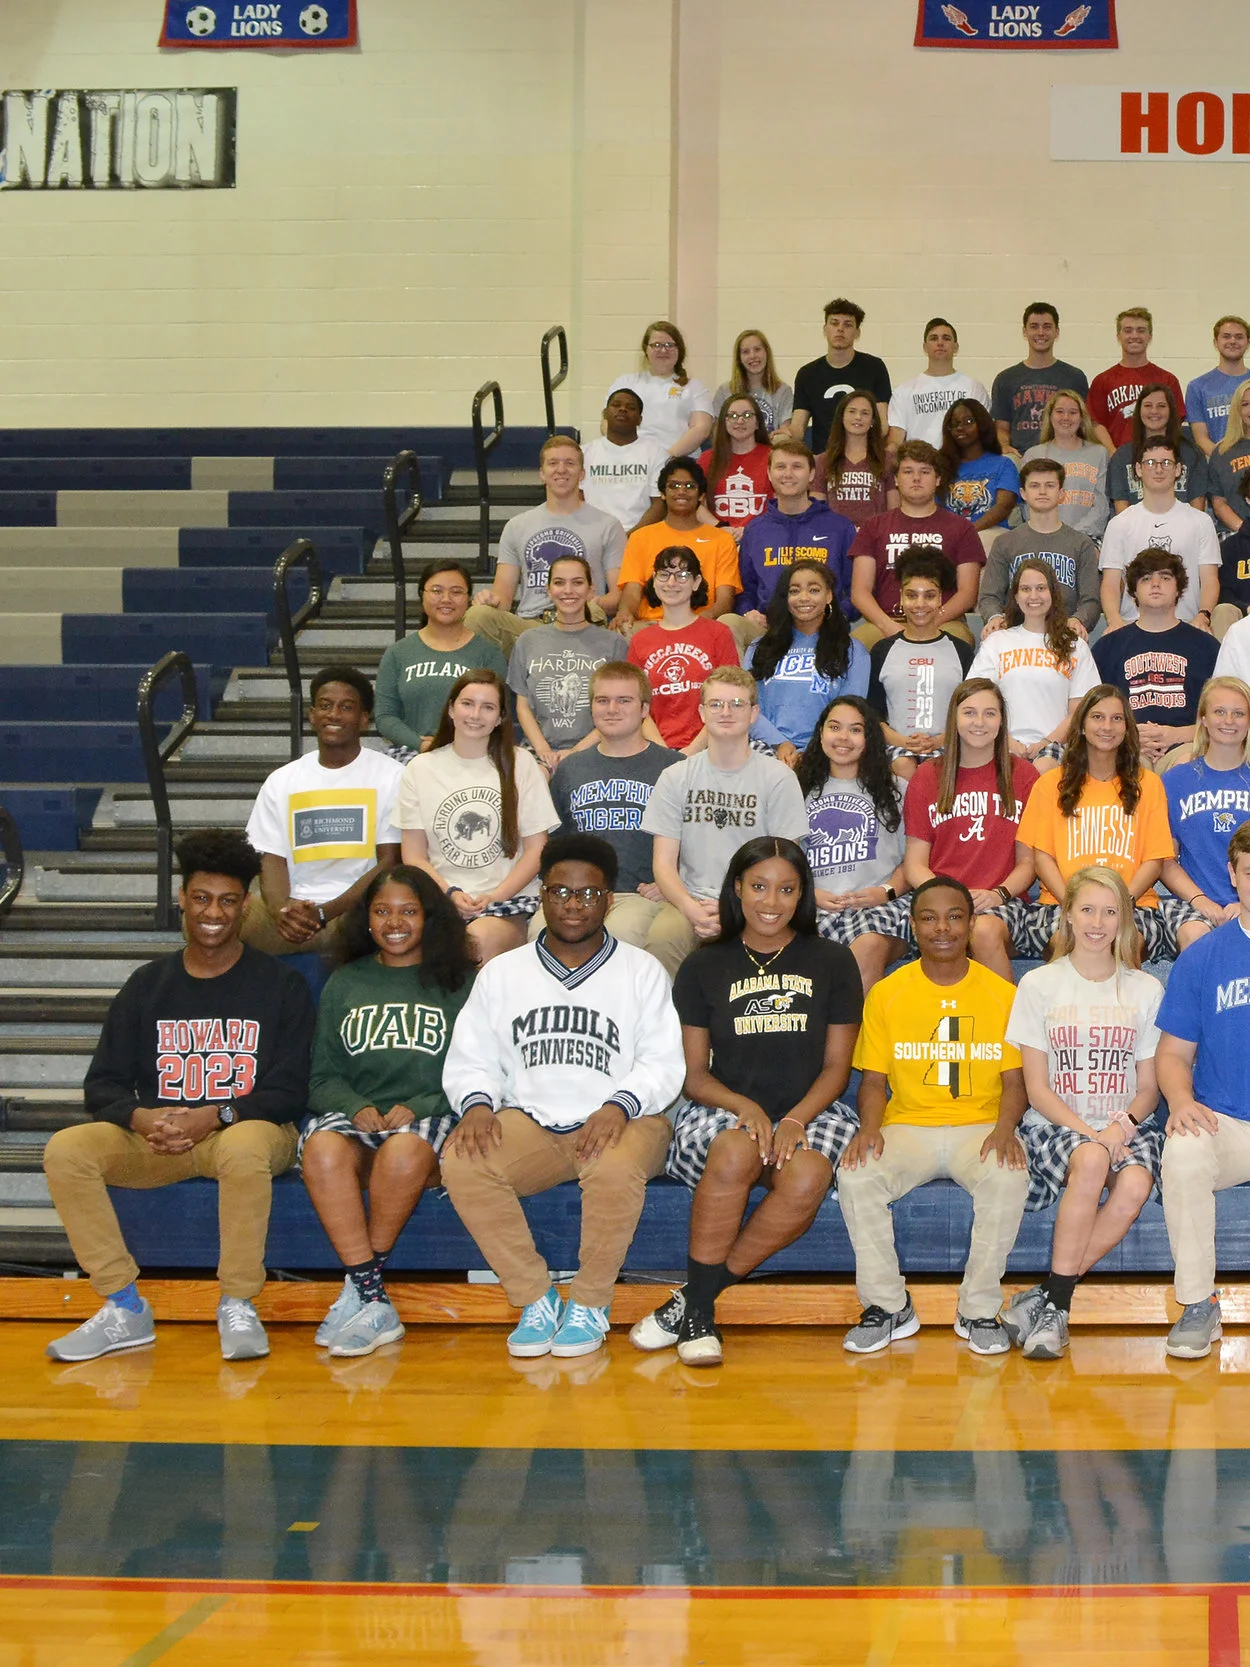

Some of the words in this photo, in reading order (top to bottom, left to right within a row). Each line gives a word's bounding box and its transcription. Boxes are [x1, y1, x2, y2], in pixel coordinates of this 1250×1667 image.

[234, 4, 281, 21] LADY
[990, 4, 1040, 21] LADY
[231, 20, 283, 37] LIONS
[988, 20, 1042, 38] LIONS
[4, 90, 219, 183] NATION
[913, 391, 956, 403] UNIVERSITY
[957, 390, 967, 400] OF
[915, 401, 955, 415] UNCOMMIT
[589, 464, 648, 477] MILLIKIN
[836, 487, 870, 501] STATE
[714, 498, 767, 518] CBU
[889, 533, 908, 544] WE
[911, 533, 943, 544] RING
[764, 547, 778, 566] L
[405, 661, 472, 683] TULAN
[908, 657, 935, 666] CBU
[998, 647, 1078, 681] TENNESE
[1124, 651, 1188, 681] SOUTHWEST
[659, 679, 691, 695] CBU
[552, 718, 576, 728] WAY
[435, 793, 468, 830] HARDING
[471, 790, 503, 812] UNIVER
[806, 795, 835, 814] PSCOMB
[838, 795, 875, 821] UNIVERSITY
[992, 793, 1022, 824] TE
[314, 817, 355, 825] RICHMOND
[314, 825, 355, 834] UNIVERSITY
[572, 807, 643, 832] TIGER
[959, 815, 986, 842] A
[1066, 804, 1139, 863] TENNESSE
[440, 838, 459, 862] FEAR
[461, 854, 479, 868] THE
[806, 839, 869, 868] BISONS
[812, 867, 835, 878] SINCE
[728, 974, 780, 1003] ALABAMA
[781, 974, 813, 998] STATE
[340, 1003, 446, 1056] UAB
[511, 1005, 621, 1055] MIDDLE
[733, 1013, 808, 1035] UNIVERSITY
[156, 1018, 260, 1053] HOWARD
[1048, 1026, 1084, 1048] HAIL
[1088, 1026, 1137, 1047] STATE
[521, 1038, 613, 1077] TENNESSEE
[893, 1041, 966, 1061] SOUTHERN
[970, 1041, 1003, 1061] MISS
[1055, 1050, 1084, 1071] AIL
[156, 1052, 258, 1101] 2023
[1053, 1072, 1084, 1094] HAL
[1087, 1072, 1129, 1094] STAT
